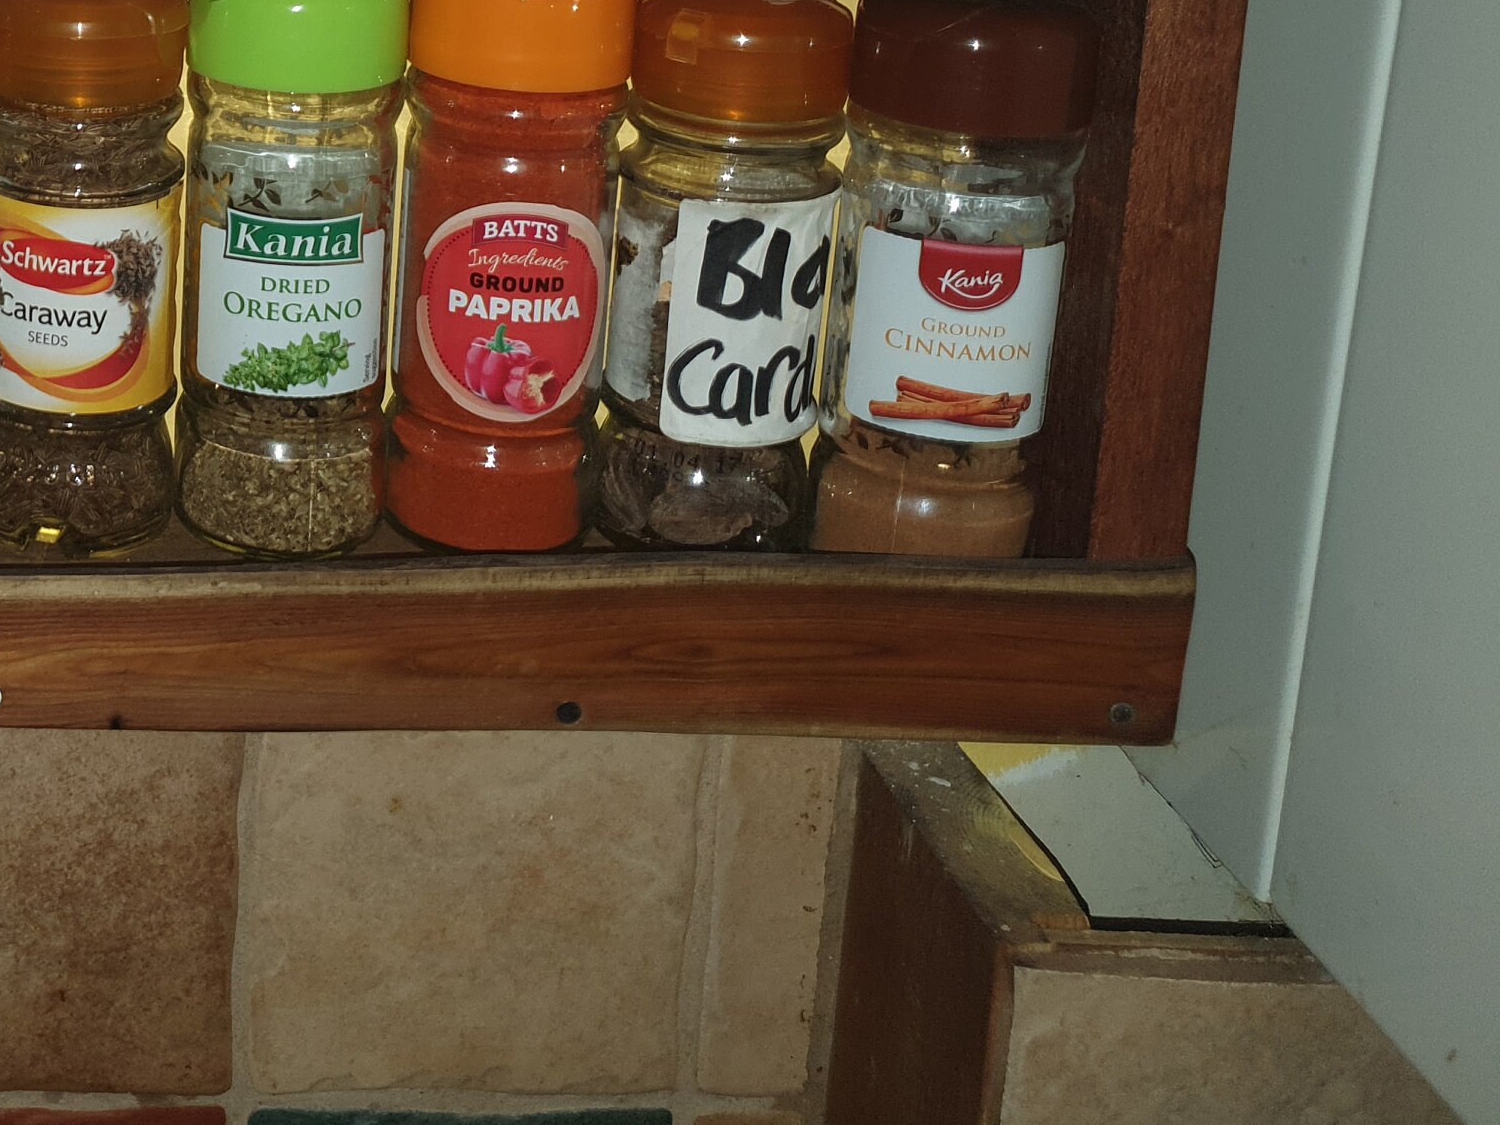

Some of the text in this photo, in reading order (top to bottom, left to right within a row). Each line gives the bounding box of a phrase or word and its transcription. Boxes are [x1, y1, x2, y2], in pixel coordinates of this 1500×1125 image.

[234, 222, 353, 257] Kania
[483, 220, 558, 242] BATTS
[1, 240, 106, 275] Schwartz
[468, 248, 569, 273] Ingredients
[261, 277, 330, 294] DRIED
[470, 272, 564, 292] GROUND
[938, 269, 1003, 299] Kania
[0, 292, 107, 335] Caraway
[224, 291, 362, 323] OREGANO
[449, 289, 580, 322] PAPRIKA
[28, 331, 68, 347] SEEDS
[921, 318, 1006, 338] GROUND
[884, 328, 1031, 361] CINNAMON
